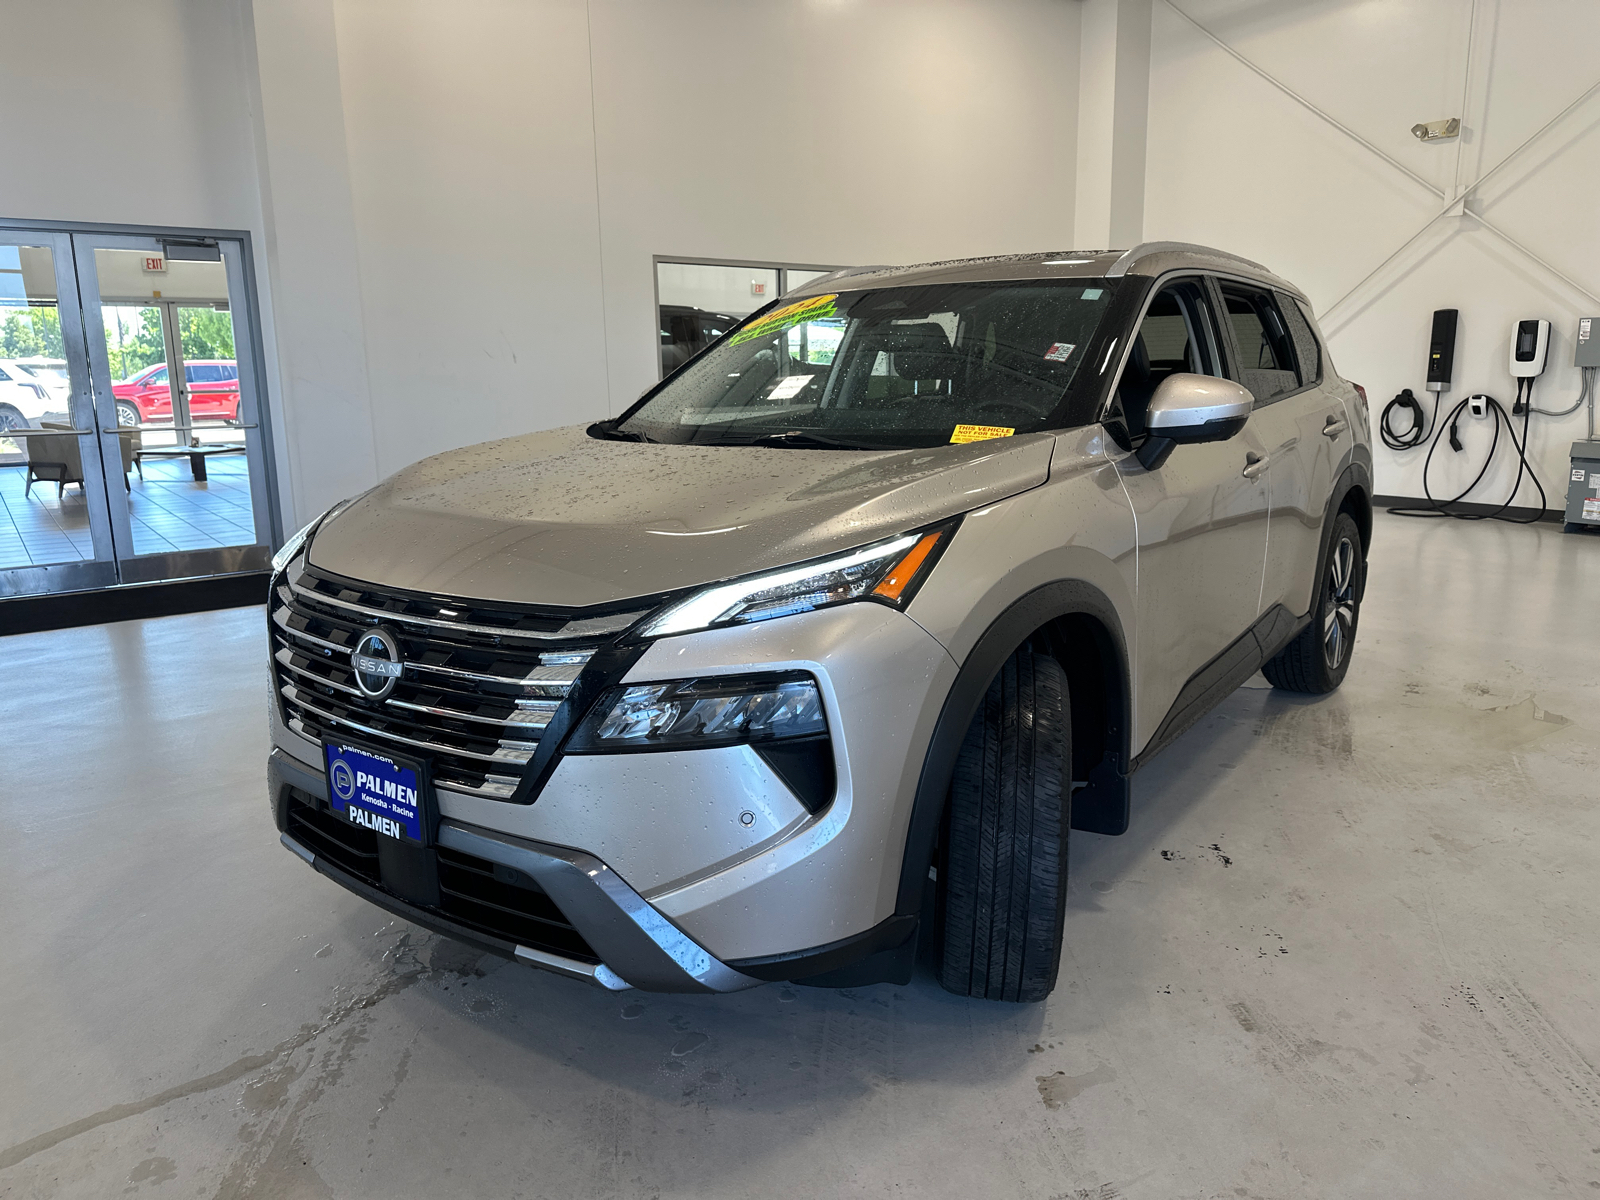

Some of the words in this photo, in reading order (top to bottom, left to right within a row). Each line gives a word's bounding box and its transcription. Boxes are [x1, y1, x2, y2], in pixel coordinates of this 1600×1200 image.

[146, 258, 163, 270] EXIT
[755, 284, 765, 293] EXIT
[796, 309, 833, 323] DRIVE
[799, 302, 832, 316] START
[978, 426, 1012, 434] VEHICLE
[351, 654, 400, 676] NISSAN
[342, 744, 394, 765] palmen.com
[356, 771, 417, 807] PALMEN
[361, 792, 388, 809] Kenosha
[392, 803, 414, 819] Racine
[349, 805, 400, 840] PALMEN
